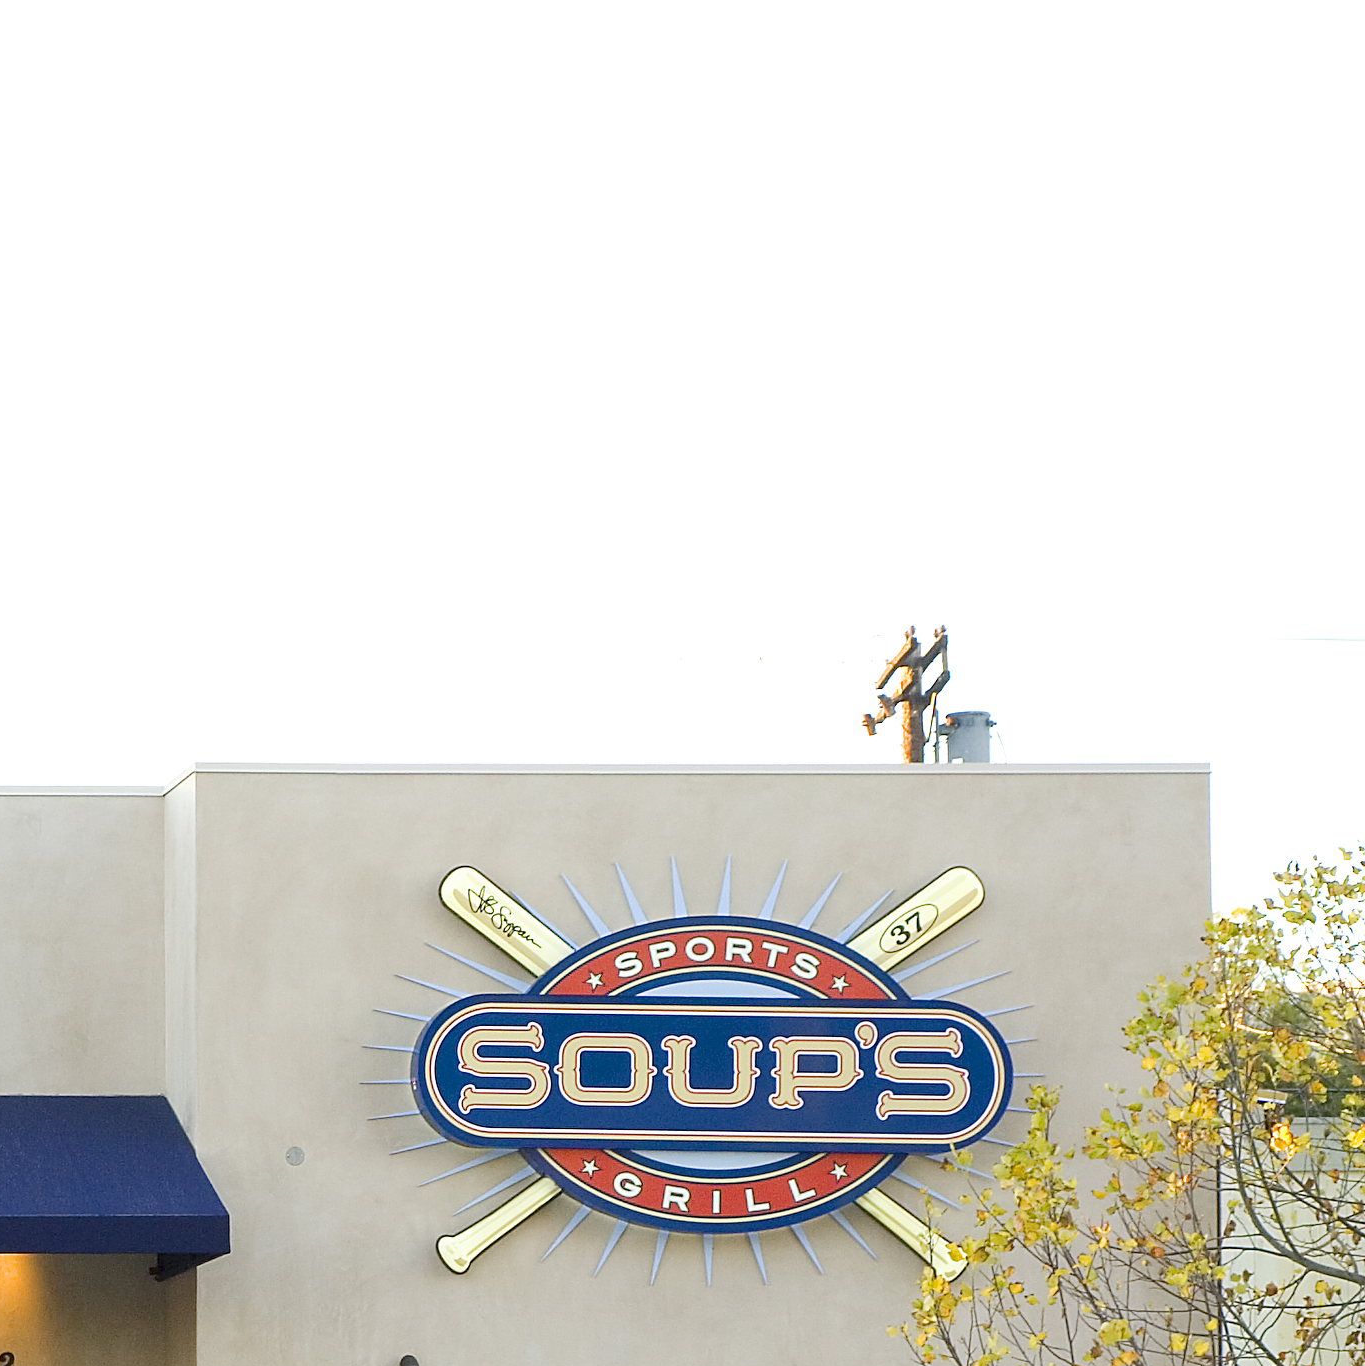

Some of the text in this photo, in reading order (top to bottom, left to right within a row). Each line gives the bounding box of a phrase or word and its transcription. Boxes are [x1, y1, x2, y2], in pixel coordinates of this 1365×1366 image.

[890, 911, 922, 945] 37
[613, 936, 820, 981] SPORTS
[457, 1021, 970, 1121] SOUP'S
[613, 1170, 817, 1215] GRILL
